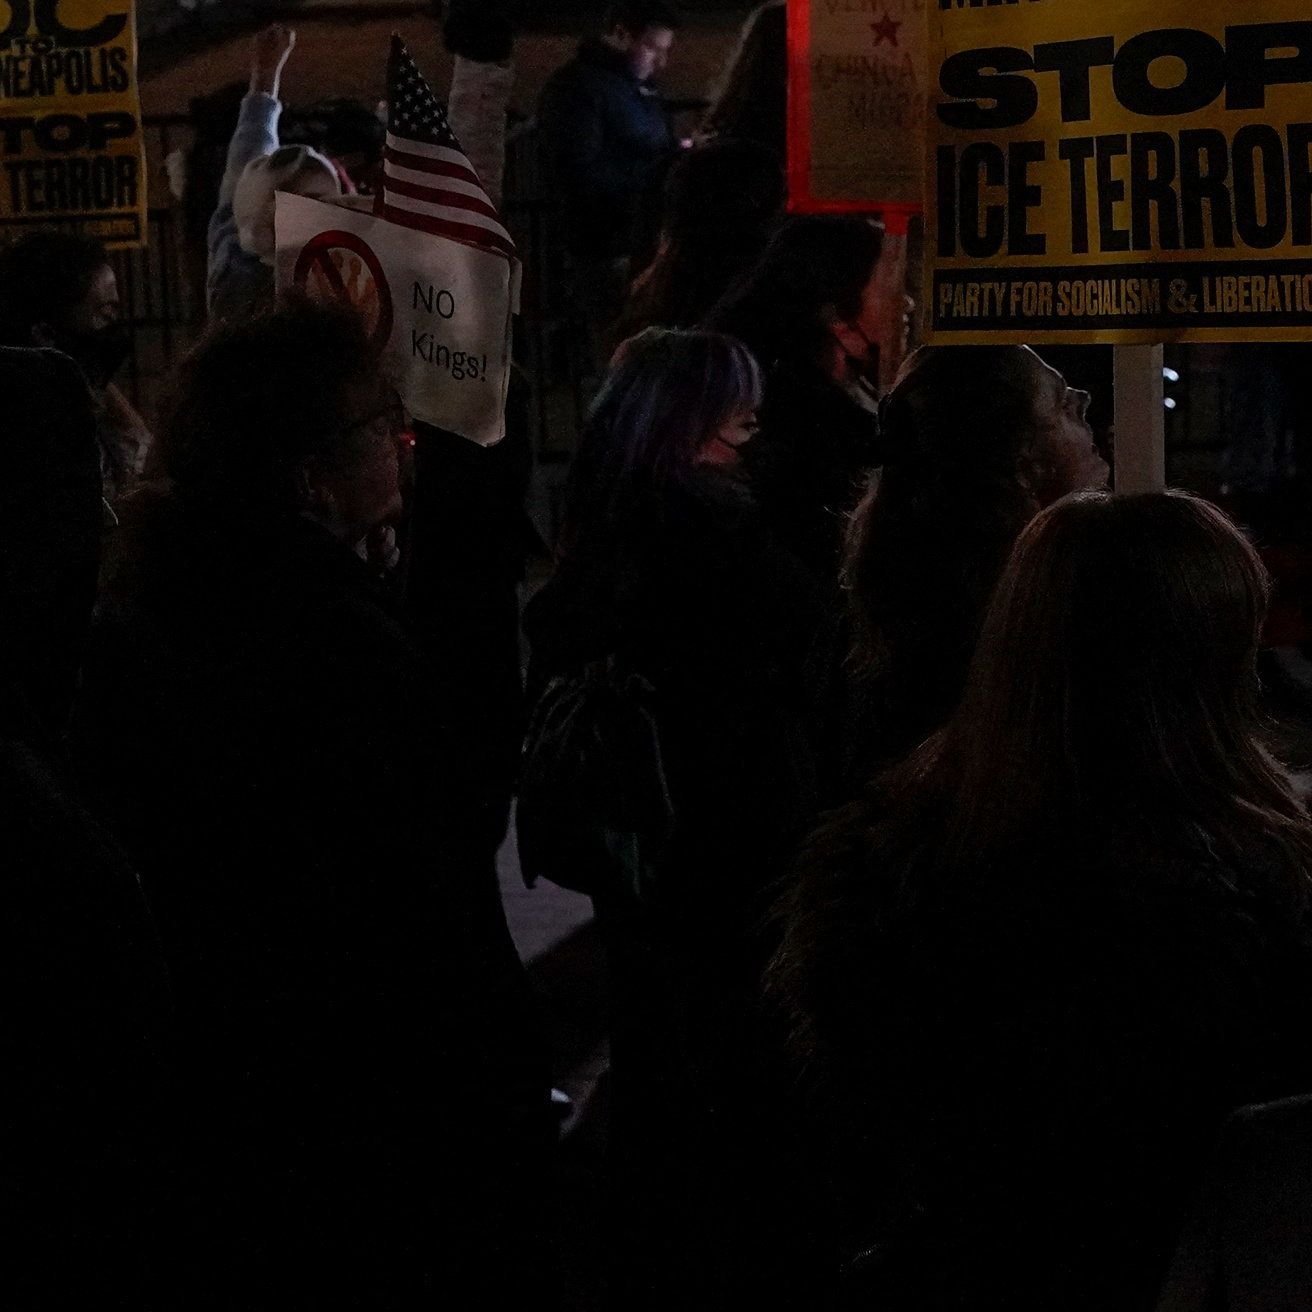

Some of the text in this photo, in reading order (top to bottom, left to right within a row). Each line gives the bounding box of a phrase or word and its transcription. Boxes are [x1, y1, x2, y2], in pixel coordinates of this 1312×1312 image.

[5, 155, 138, 213] TERROR
[937, 139, 1046, 258] ICE
[412, 281, 455, 319] NO
[939, 282, 1008, 319] PARTY
[1009, 280, 1057, 317] FOR
[1057, 277, 1162, 317] SOCIALISM
[1167, 278, 1200, 315] &
[411, 329, 487, 383] Kings!
